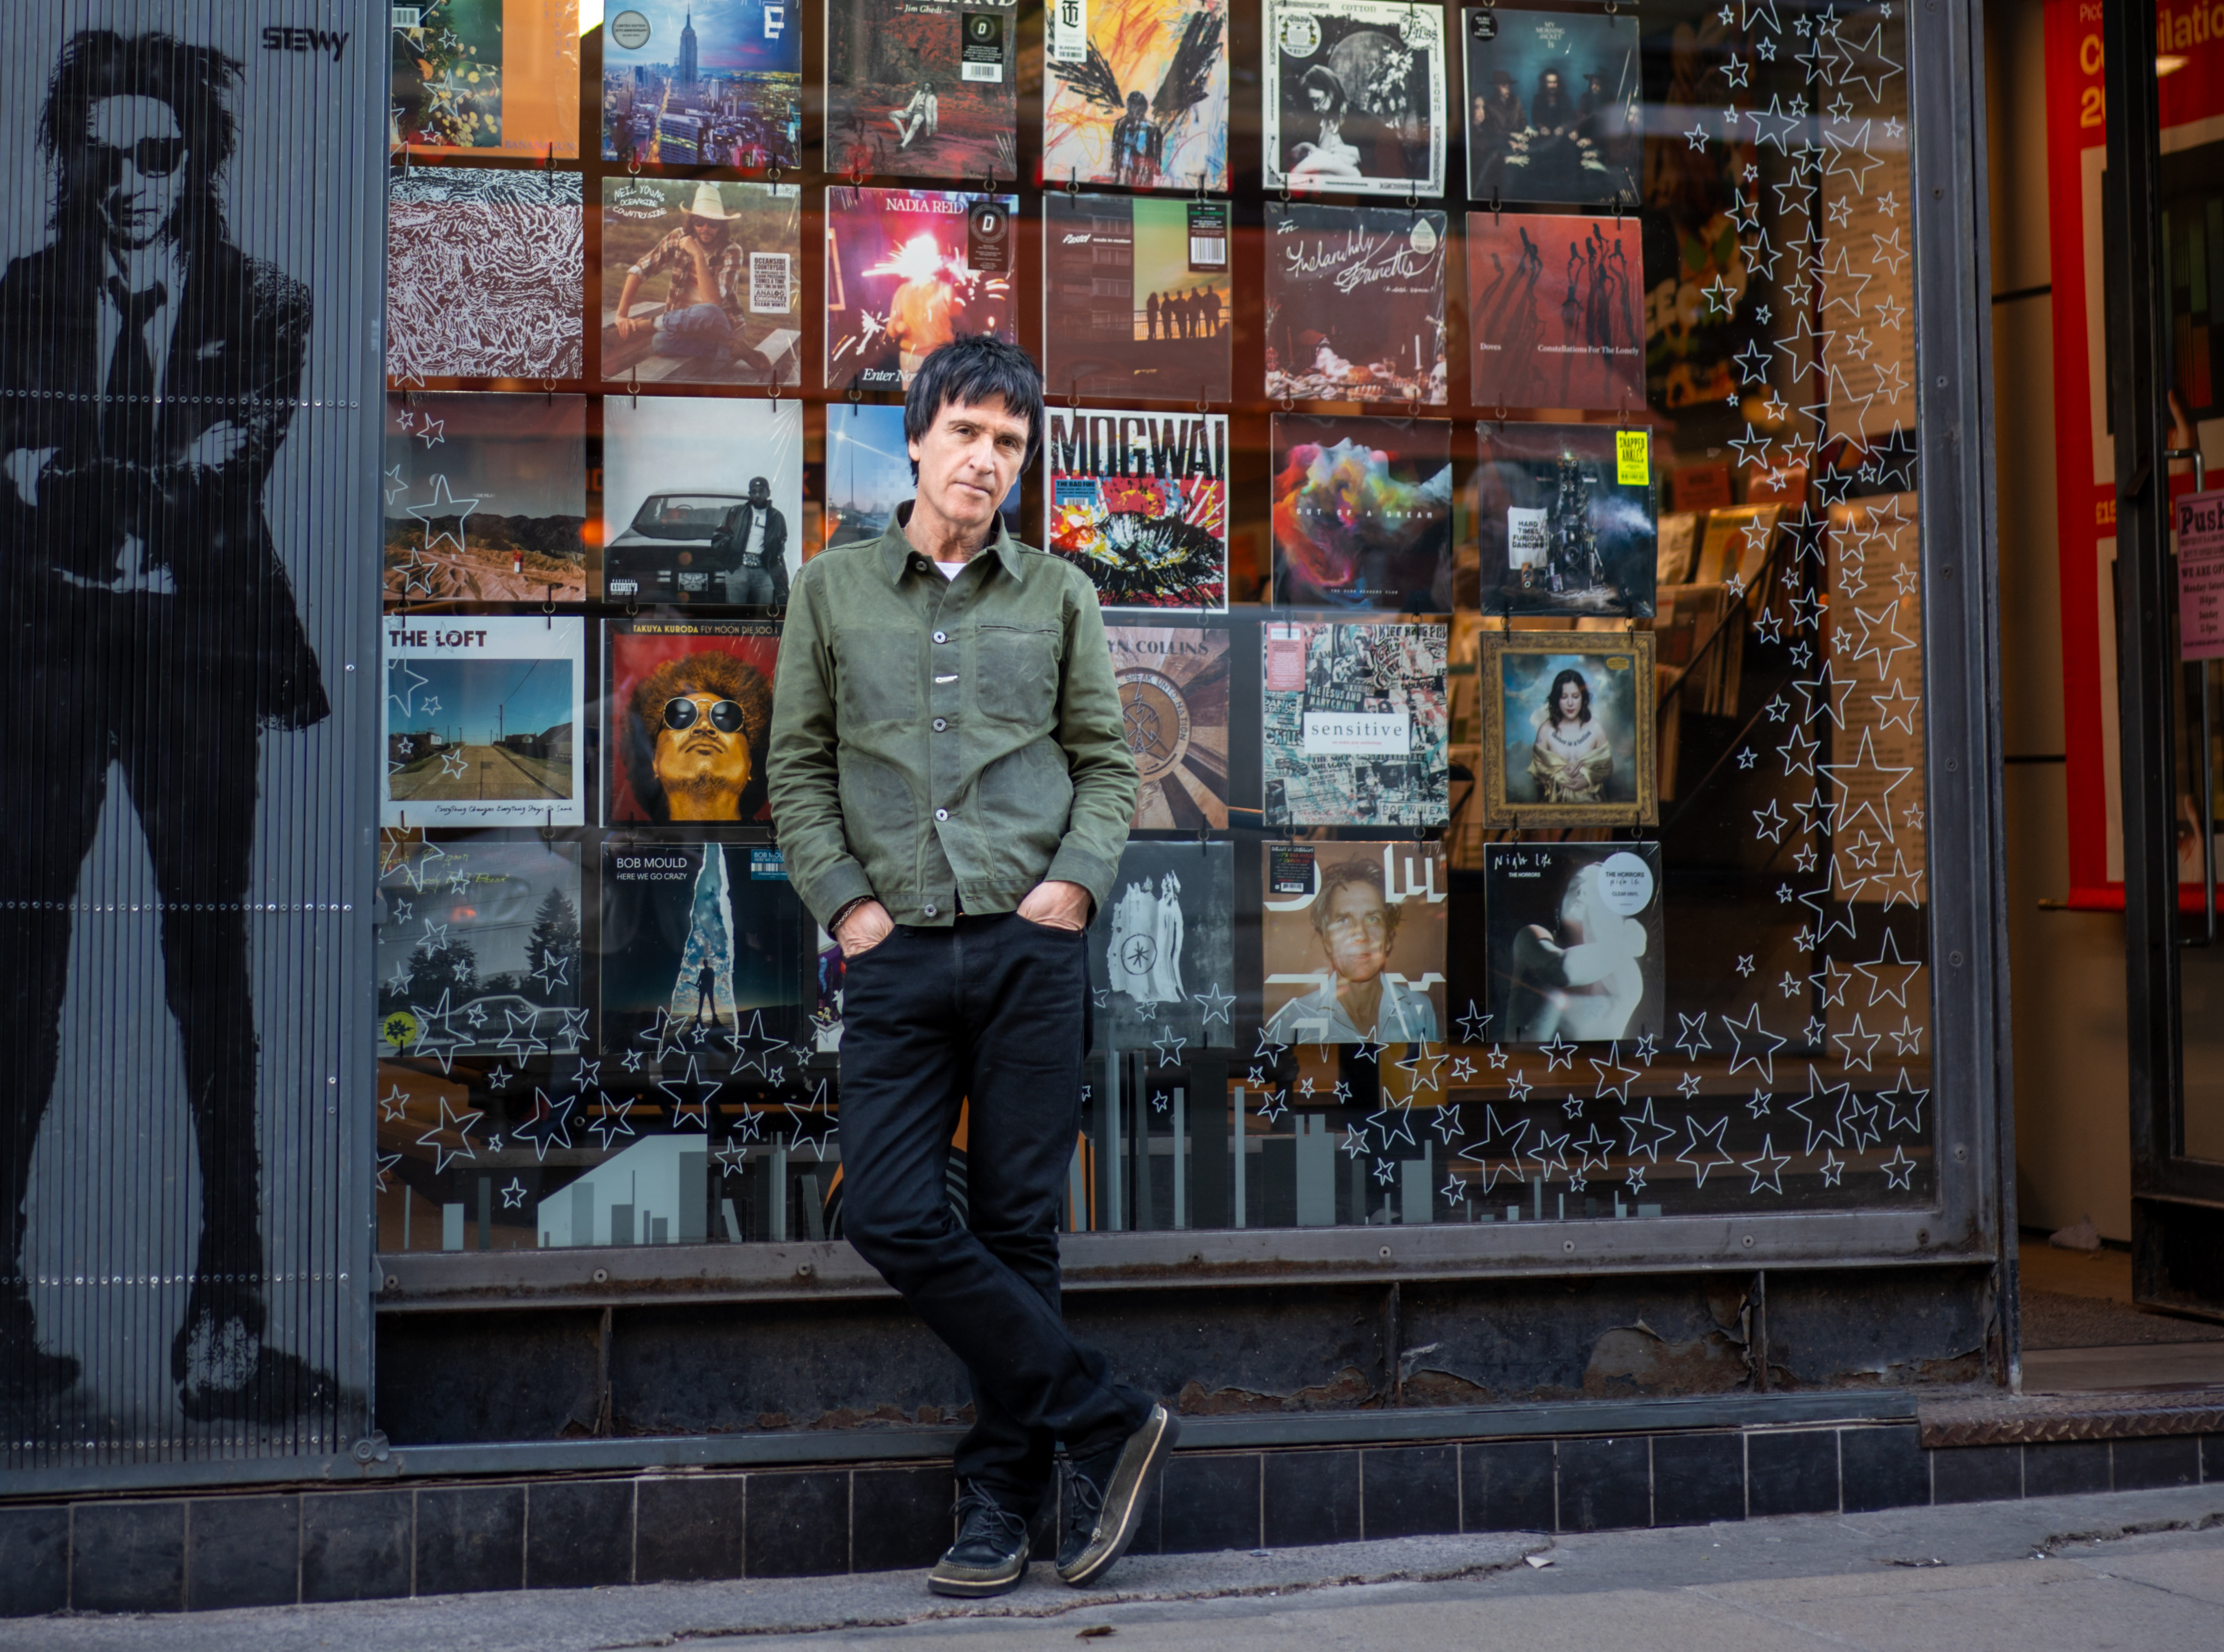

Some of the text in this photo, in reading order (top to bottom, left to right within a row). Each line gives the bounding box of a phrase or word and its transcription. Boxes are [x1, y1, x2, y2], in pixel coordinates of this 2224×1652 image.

[904, 4, 943, 14] Jim Ghedi
[1536, 26, 1565, 35] MORNING
[614, 184, 665, 202] NEIL YOUNG
[620, 197, 659, 208] OCEANSIDE
[885, 198, 964, 215] NADIA REID
[612, 206, 667, 219] COUNTRYSIDE
[982, 215, 995, 233] D
[1062, 233, 1092, 244] Pastel
[1480, 342, 1640, 356] Doves Constellations For The Lonely
[862, 368, 895, 382] Enter
[1050, 415, 1225, 481] MOGWAI
[1619, 437, 1645, 448] SNAPPED
[1387, 511, 1432, 519] DREAM
[2196, 565, 2211, 577] ARE
[633, 625, 662, 633] TAKUYA
[714, 626, 739, 634] MOON
[388, 630, 487, 647] THE LOFT
[1136, 640, 1209, 656] COLLINS
[1307, 685, 1321, 696] THE
[1322, 687, 1345, 699] JESUS
[1345, 690, 1362, 702] AND
[1125, 673, 1188, 742] SPEAK UNTO NATION
[1309, 696, 1330, 708] MARY
[1330, 699, 1355, 712] CHAIN
[1311, 721, 1403, 737] sensitive
[469, 805, 494, 816] Changes
[527, 805, 545, 816] Stays
[1383, 805, 1403, 815] POP
[617, 858, 687, 869] BOB MOULD
[616, 872, 636, 881] HERE
[650, 872, 663, 881] GO
[664, 872, 688, 881] CRAZY
